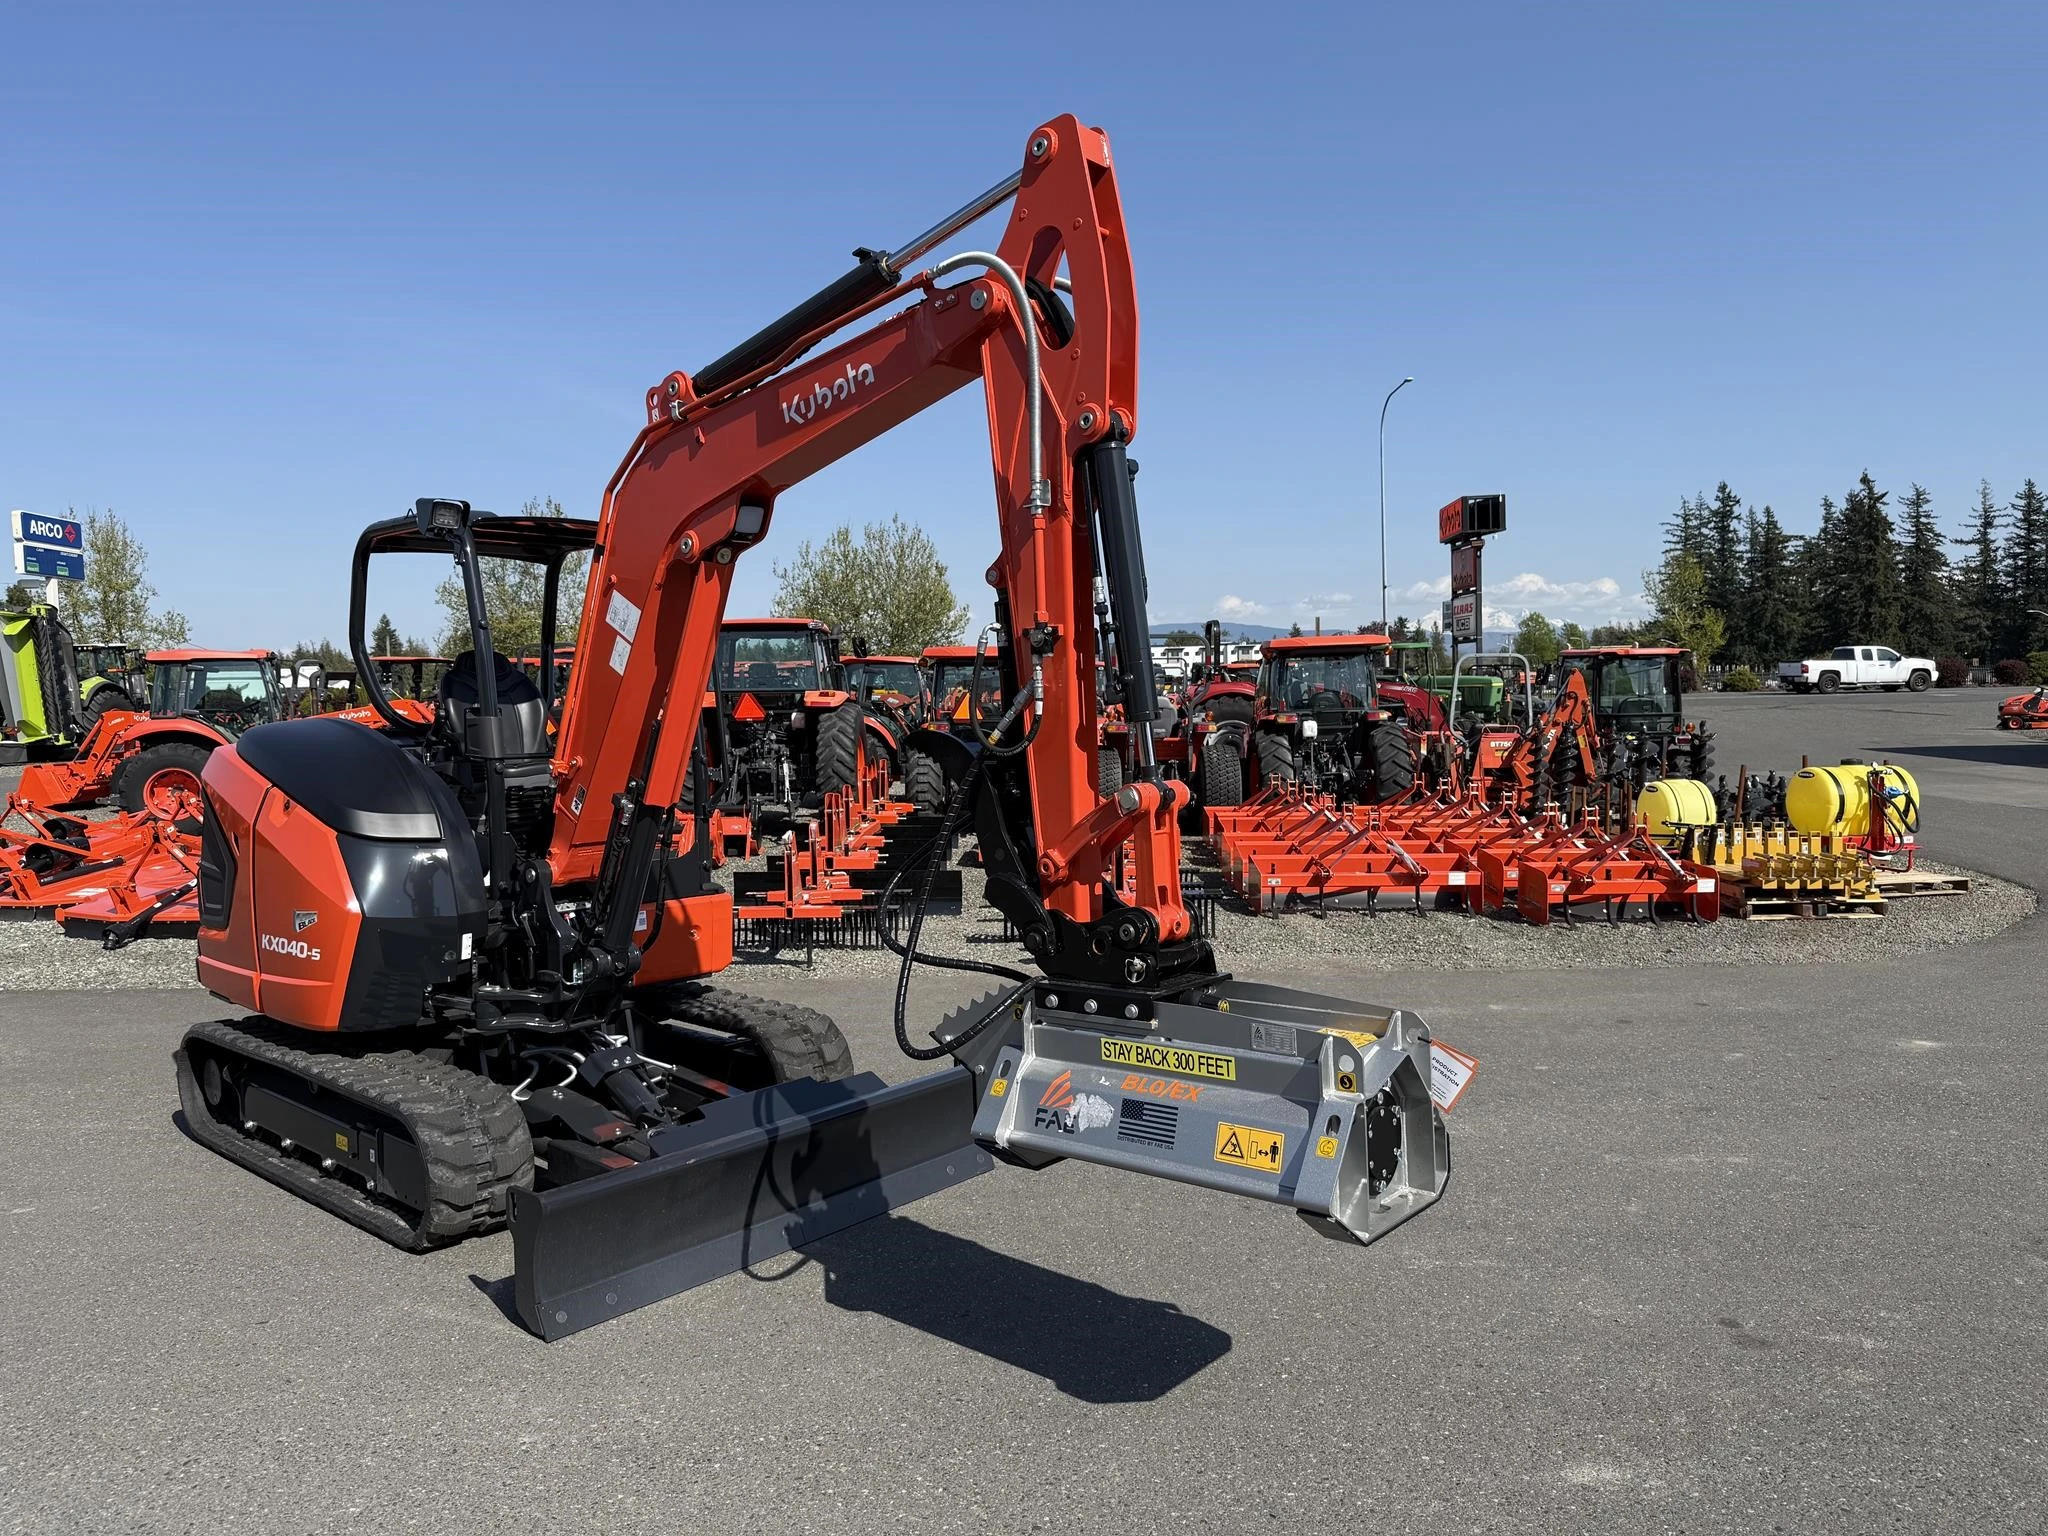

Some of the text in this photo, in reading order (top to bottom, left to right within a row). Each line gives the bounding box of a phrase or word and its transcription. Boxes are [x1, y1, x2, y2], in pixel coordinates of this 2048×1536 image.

[782, 363, 875, 424] Kubota
[30, 519, 62, 539] ARCO
[1454, 603, 1473, 615] CLAAS
[1456, 619, 1470, 631] JCB
[339, 709, 371, 720] Kubota
[1103, 1041, 1232, 1077] STAY BACK 300 FEET
[1432, 1056, 1458, 1077] PRODUCT
[1432, 1063, 1459, 1087] ISTRATION
